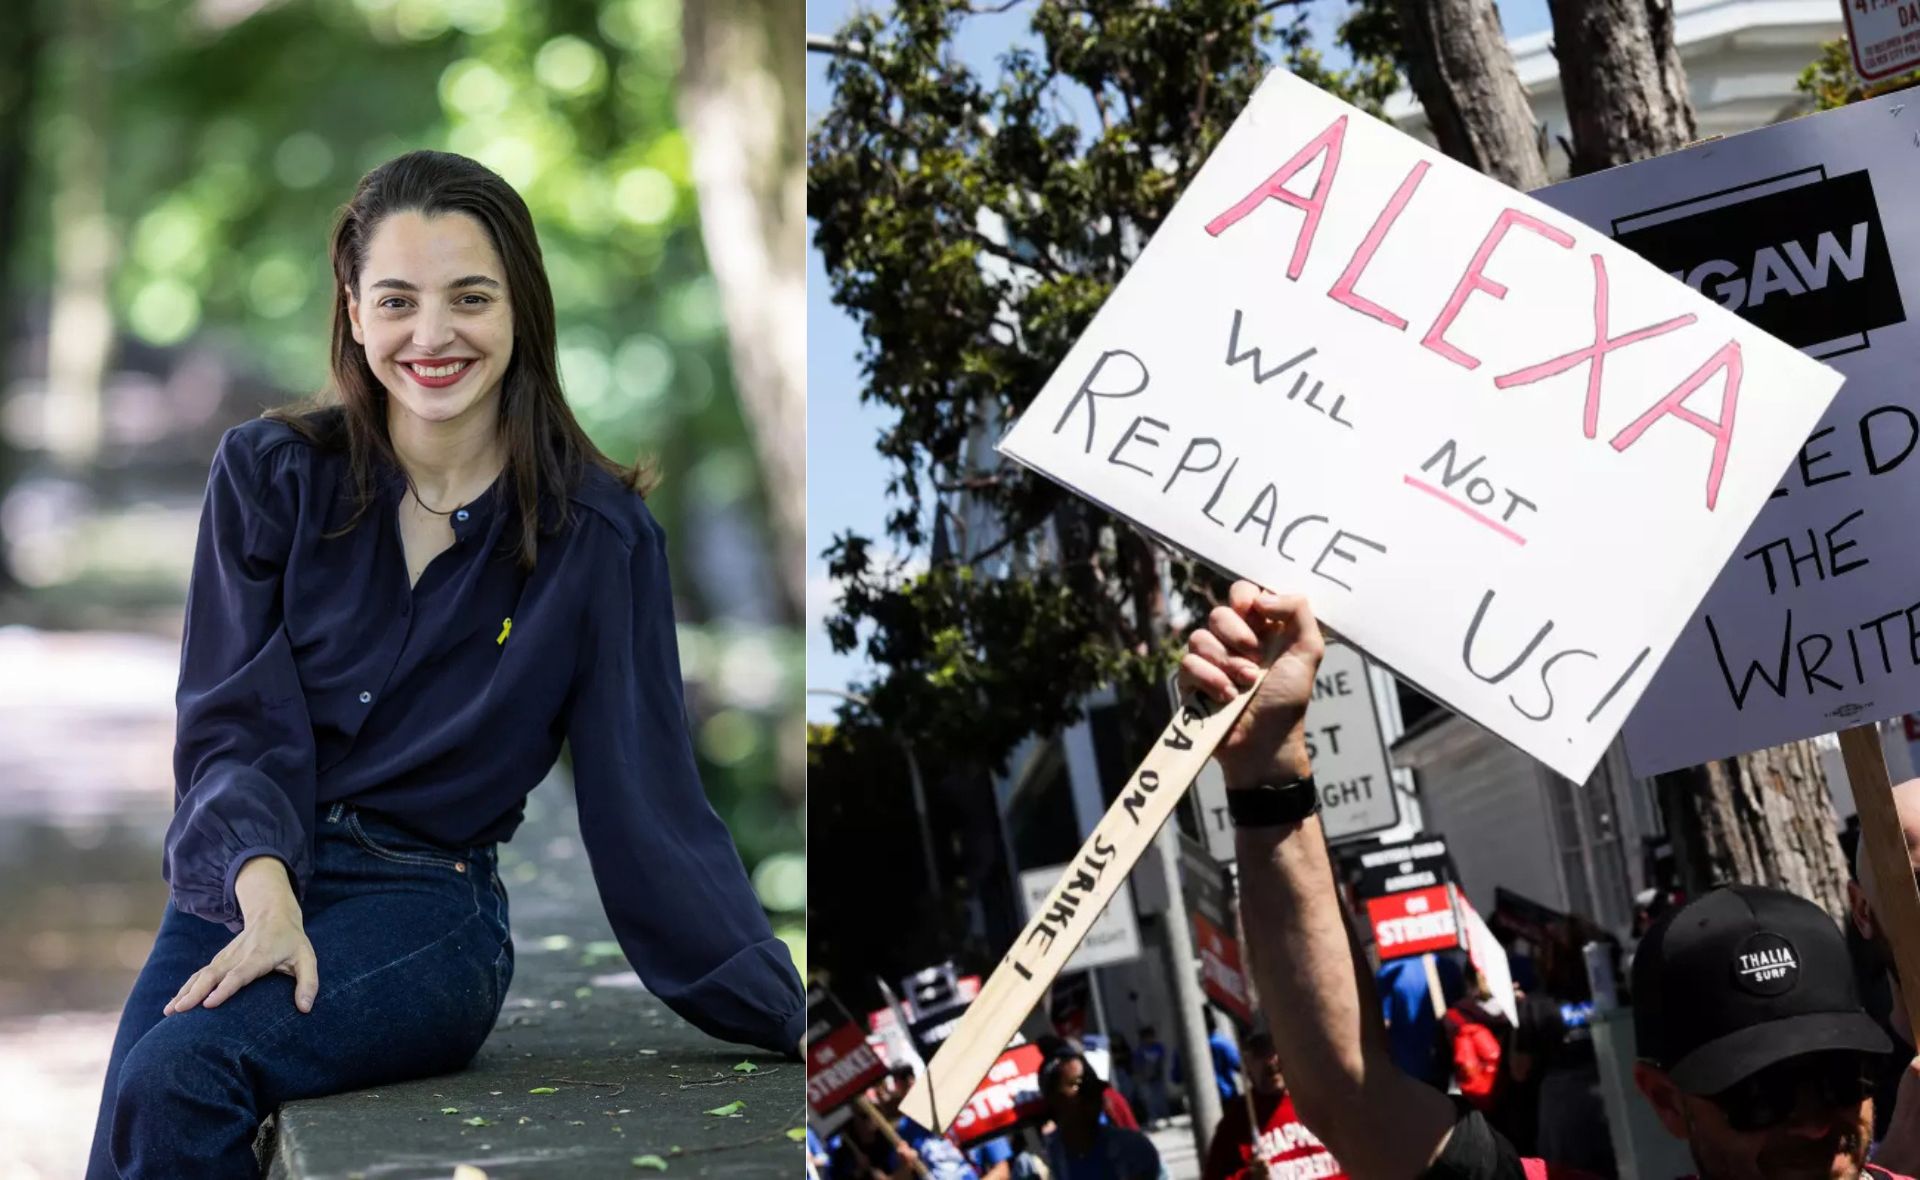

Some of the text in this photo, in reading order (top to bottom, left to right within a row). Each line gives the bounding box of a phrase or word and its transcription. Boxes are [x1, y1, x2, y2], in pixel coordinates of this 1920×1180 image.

[1669, 221, 1868, 312] GAW
[1205, 115, 1741, 511] ALEXA
[1226, 310, 1538, 522] WILL NOT
[1771, 405, 1920, 498] ED
[1053, 349, 1651, 744] REPLACE US!
[1744, 509, 1870, 595] THE
[1312, 670, 1353, 701] NE
[1123, 769, 1160, 826] ON
[1210, 775, 1374, 832] T GHT
[1739, 947, 1793, 969] THALIA
[1755, 966, 1787, 982] SURF
